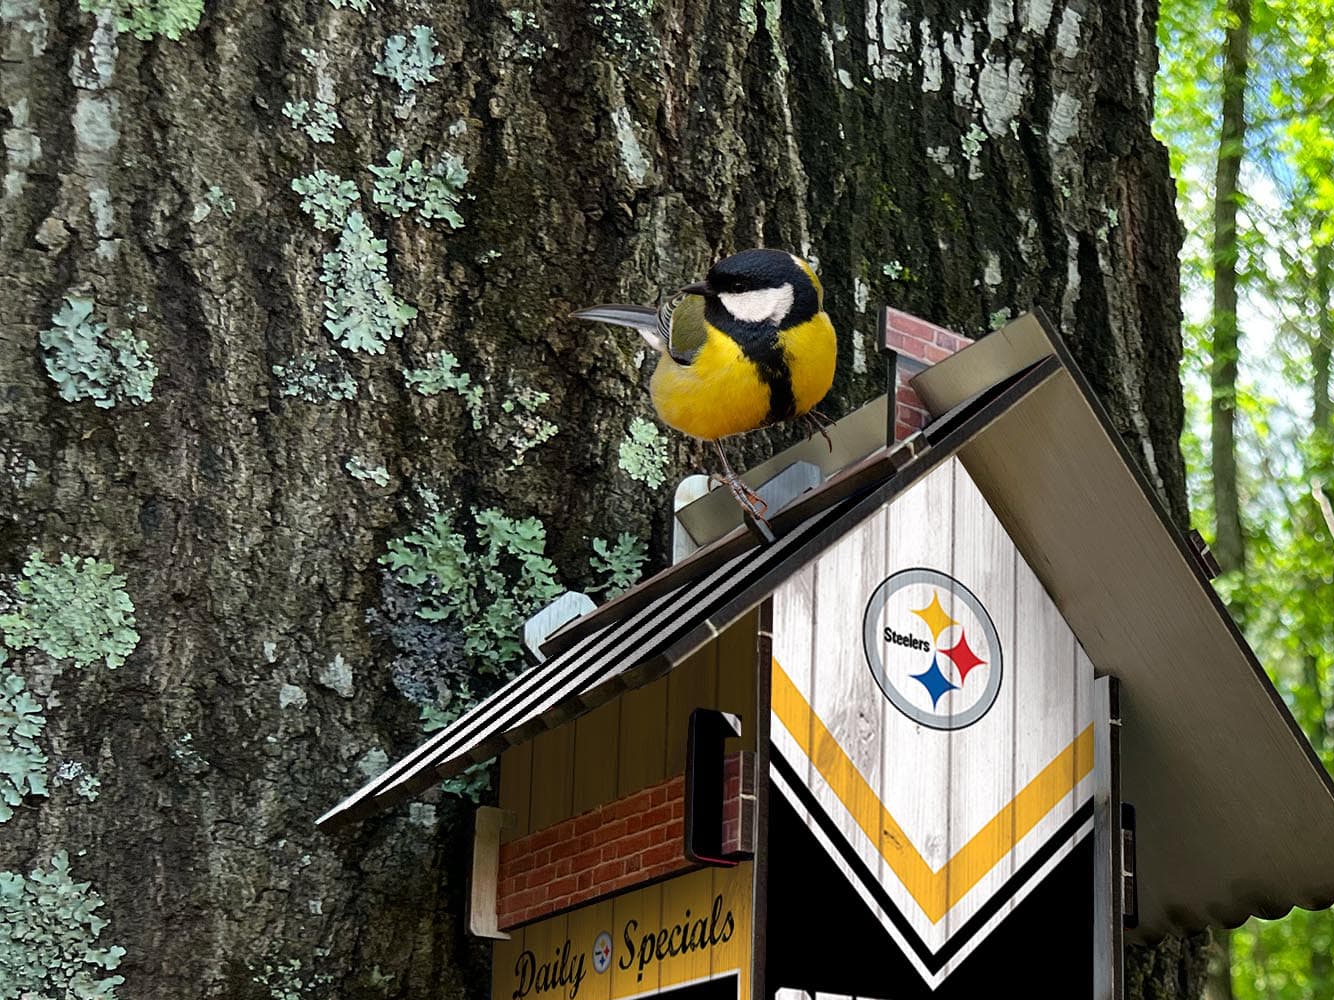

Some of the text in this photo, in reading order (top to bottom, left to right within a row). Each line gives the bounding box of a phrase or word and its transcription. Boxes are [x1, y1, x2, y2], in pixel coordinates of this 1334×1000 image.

[884, 626, 931, 653] Steelers
[512, 893, 735, 1000] Daily Specials
